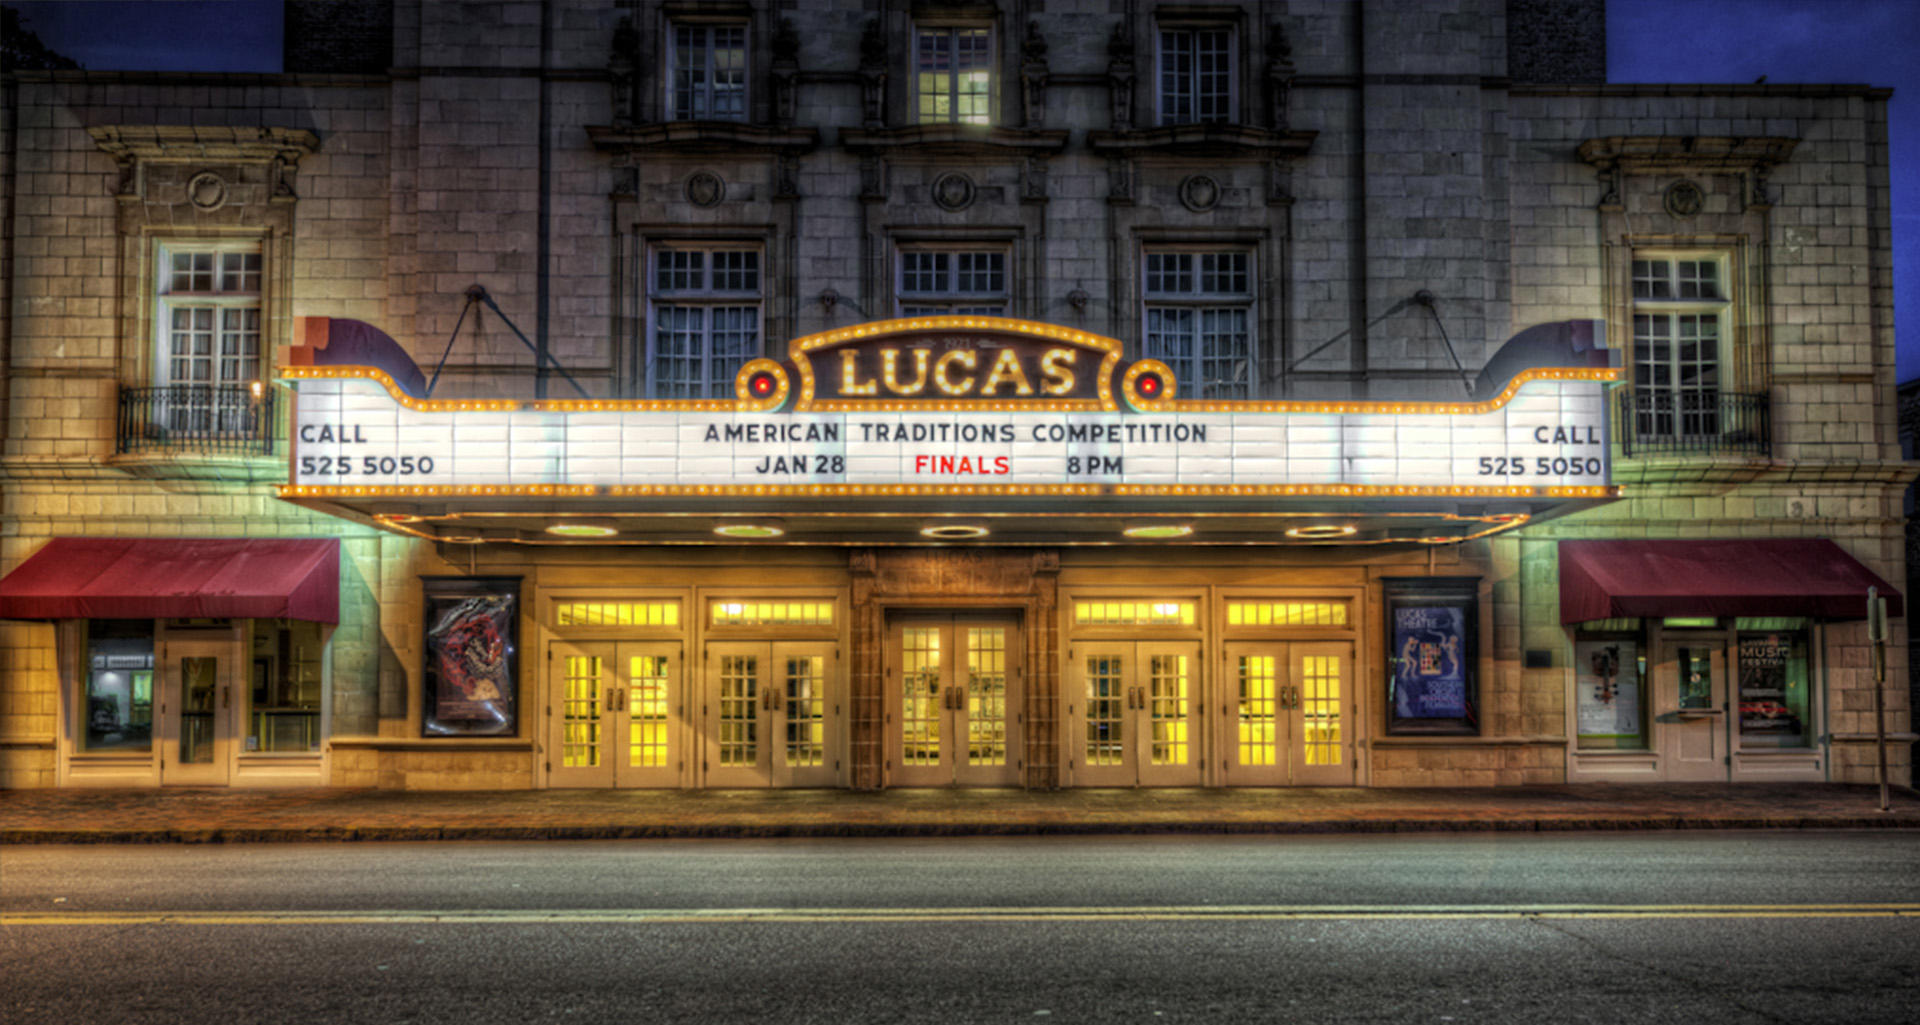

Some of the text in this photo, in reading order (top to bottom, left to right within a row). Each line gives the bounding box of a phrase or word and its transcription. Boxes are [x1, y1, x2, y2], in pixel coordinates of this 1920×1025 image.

[838, 349, 1076, 395] LUCAS
[301, 424, 367, 443] CALL
[705, 423, 1206, 442] AMERICAN TRADITIONS COMPETITION
[1534, 425, 1600, 444] CALL
[301, 456, 434, 475] 525 5050
[756, 455, 1123, 475] JAN 28 FINALS 8 PM
[1479, 457, 1601, 476] 525 5050
[925, 549, 983, 564] LUCAS
[1396, 609, 1427, 619] LUCAS
[1397, 619, 1438, 629] THEATRE
[1741, 647, 1791, 658] MUSIC
